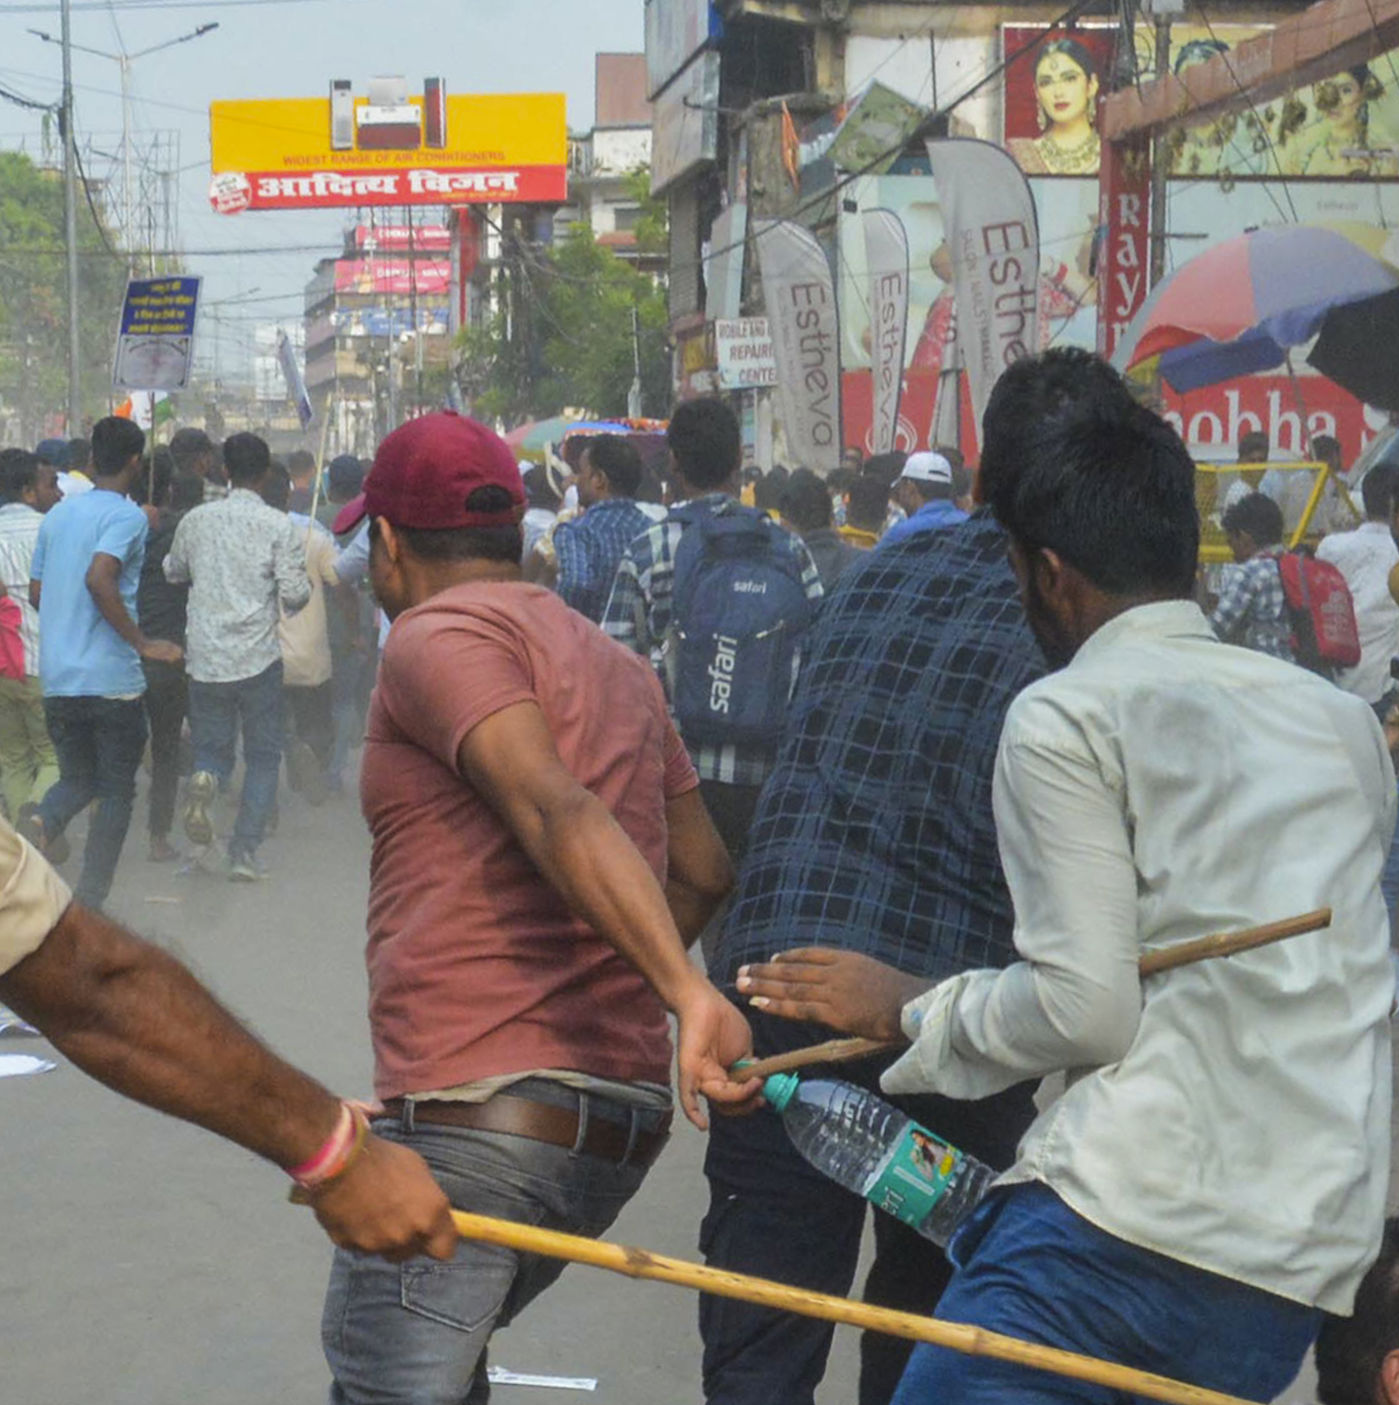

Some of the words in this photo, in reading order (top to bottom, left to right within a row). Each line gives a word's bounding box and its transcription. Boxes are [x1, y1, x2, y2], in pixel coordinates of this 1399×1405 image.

[282, 155, 327, 167] WIDEST
[331, 154, 372, 165] RANGE
[374, 153, 391, 164] OF
[394, 152, 414, 163] AIR
[415, 150, 507, 163] CONDITIONERS
[257, 173, 400, 198] आदित्य
[981, 220, 1037, 367] Esthe
[739, 366, 776, 384] CENTE
[790, 280, 833, 448] Estheva
[733, 580, 767, 595] safari
[708, 632, 738, 714] safari
